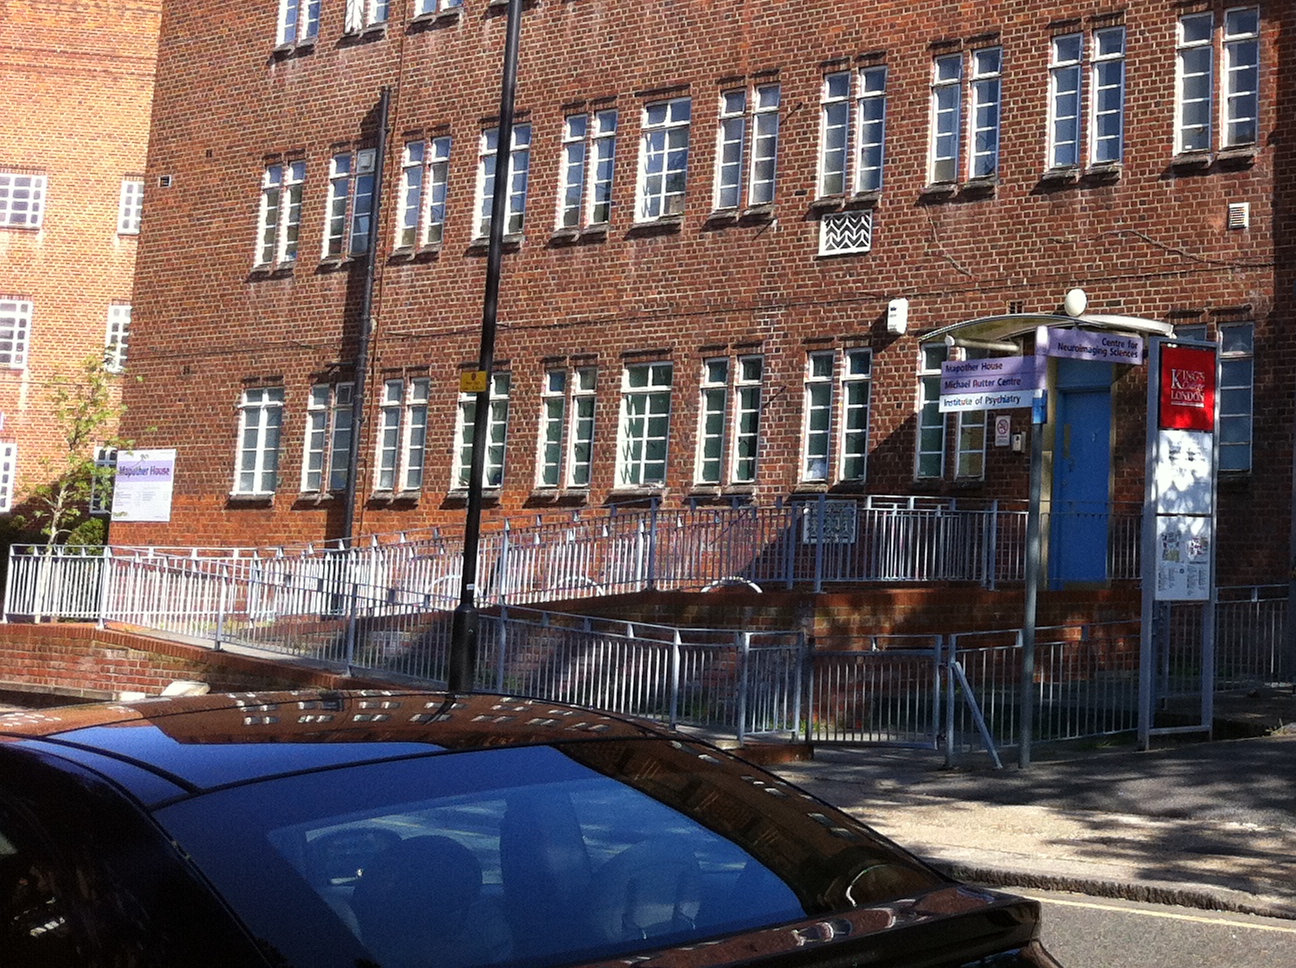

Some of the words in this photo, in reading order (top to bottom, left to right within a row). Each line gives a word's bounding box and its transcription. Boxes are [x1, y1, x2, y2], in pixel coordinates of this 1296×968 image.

[1102, 338, 1125, 348] Centre
[1128, 340, 1138, 349] for
[1057, 343, 1107, 357] Neuroimaging
[1110, 347, 1138, 358] Sciences
[945, 364, 978, 374] Mapother
[981, 362, 1003, 371] House
[945, 380, 971, 389] Michael
[972, 379, 995, 387] Rutter
[997, 378, 1021, 386] Centre
[944, 398, 972, 407] Institute
[975, 396, 984, 405] of
[985, 395, 1021, 406] Psychiatry
[1171, 390, 1205, 402] LONDON
[150, 466, 170, 476] House
